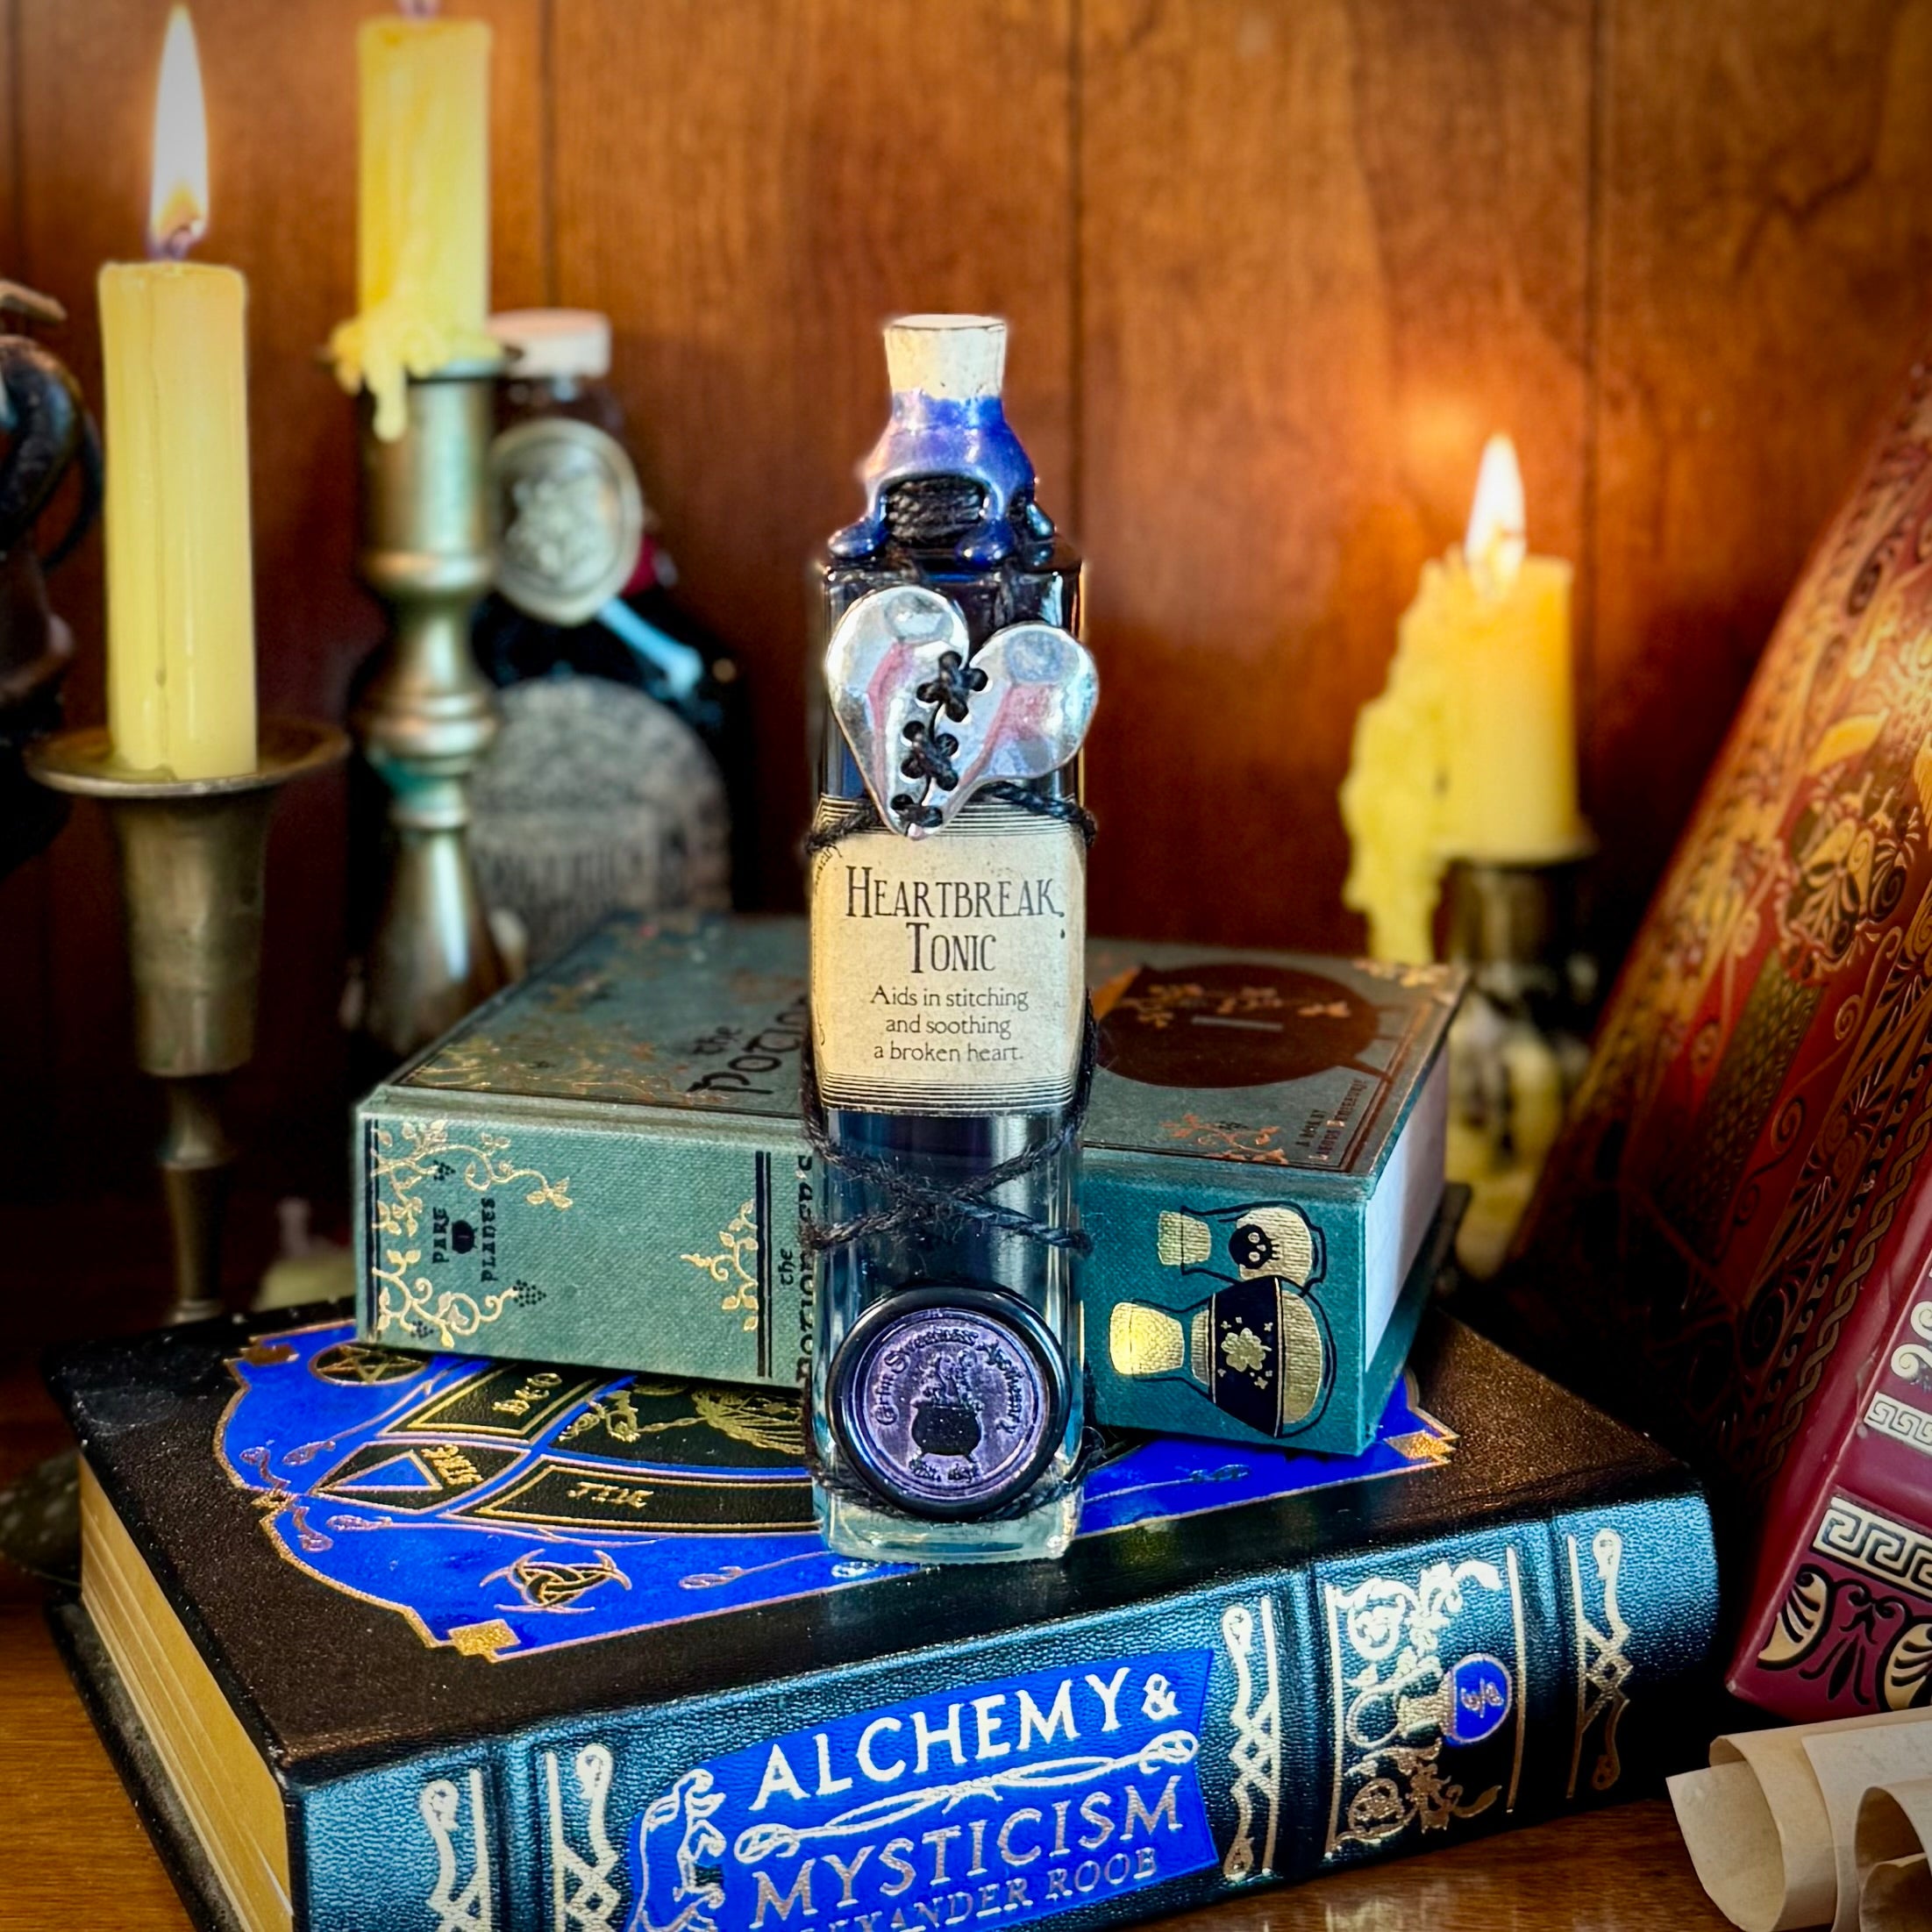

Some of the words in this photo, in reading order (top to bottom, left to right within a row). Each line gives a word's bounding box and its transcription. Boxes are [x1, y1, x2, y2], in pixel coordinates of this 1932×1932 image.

[845, 865, 1066, 918] HEARTBREAK
[905, 922, 997, 973] TONIC
[870, 984, 918, 1006] Aids
[923, 987, 941, 1007] in
[945, 986, 1030, 1012] stitching
[873, 1045, 885, 1059] a
[889, 1040, 961, 1062] broken
[967, 1042, 1024, 1062] heart.
[886, 1014, 921, 1034] and
[925, 1015, 1012, 1041] soothing
[748, 1666, 1131, 1813] ALCHEMY
[1141, 1672, 1181, 1722] &
[749, 1774, 1184, 1929] MYSTICISM
[800, 1877, 1033, 1932] XANDER
[1044, 1846, 1158, 1901] ROOB
